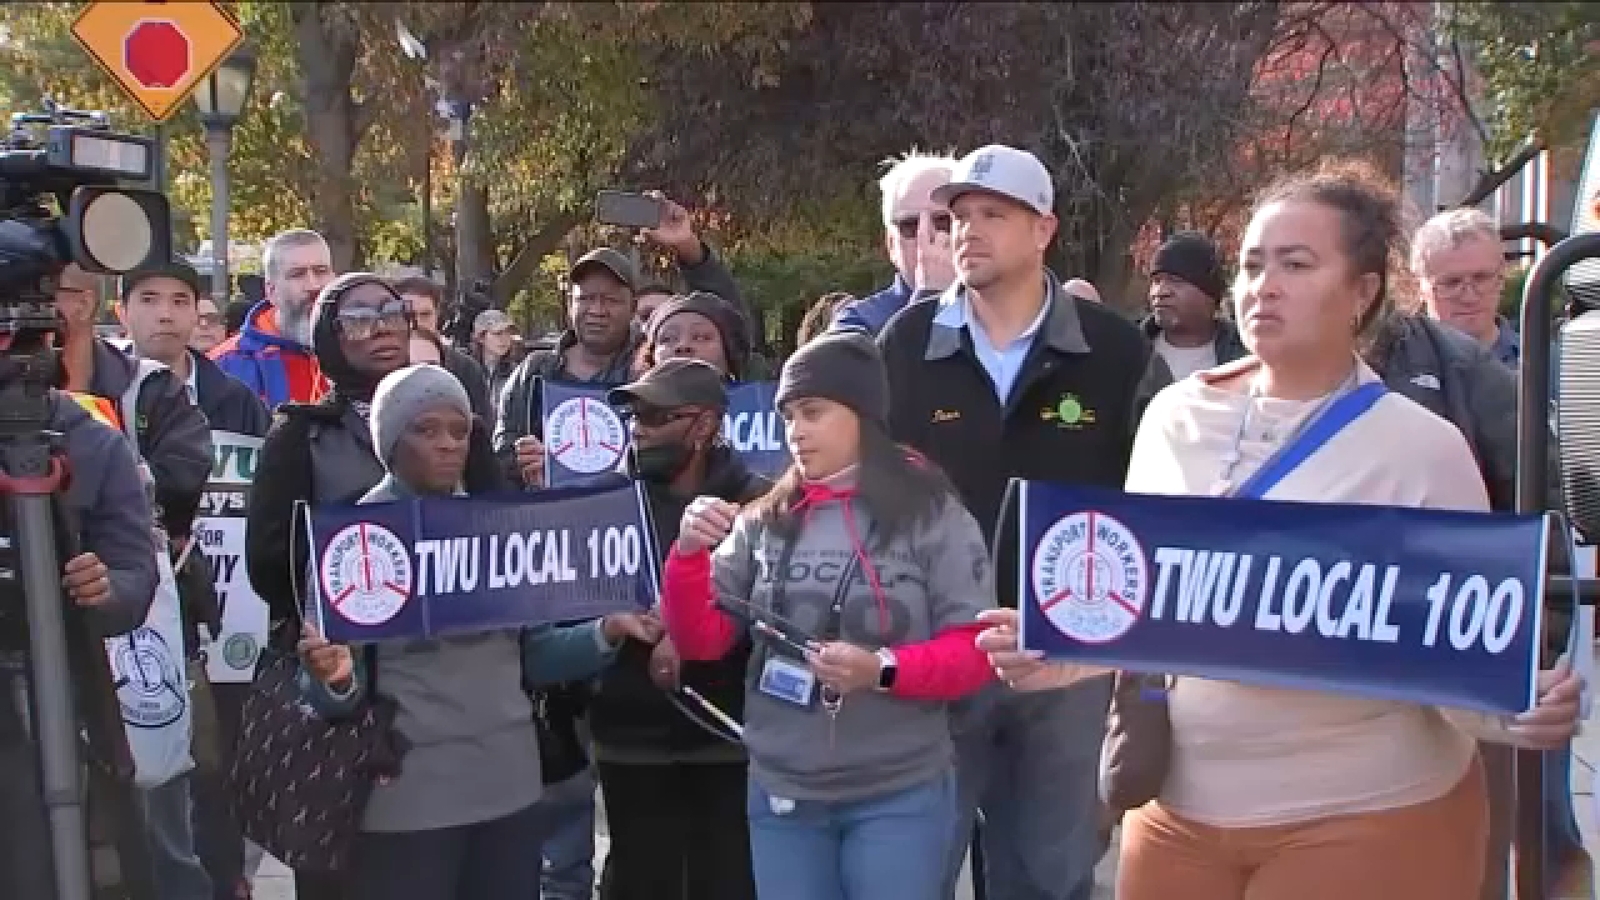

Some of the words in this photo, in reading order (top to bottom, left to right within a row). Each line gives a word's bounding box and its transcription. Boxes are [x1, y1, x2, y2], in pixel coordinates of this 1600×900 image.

[415, 537, 480, 596] TWU
[489, 530, 577, 589] LOCAL
[588, 525, 640, 579] 100
[1040, 522, 1086, 598] TRANSPORT
[1097, 523, 1139, 601] WORKERS
[1151, 547, 1252, 627] TWU
[1254, 556, 1400, 643] LOCAL
[1422, 572, 1524, 653] 100
